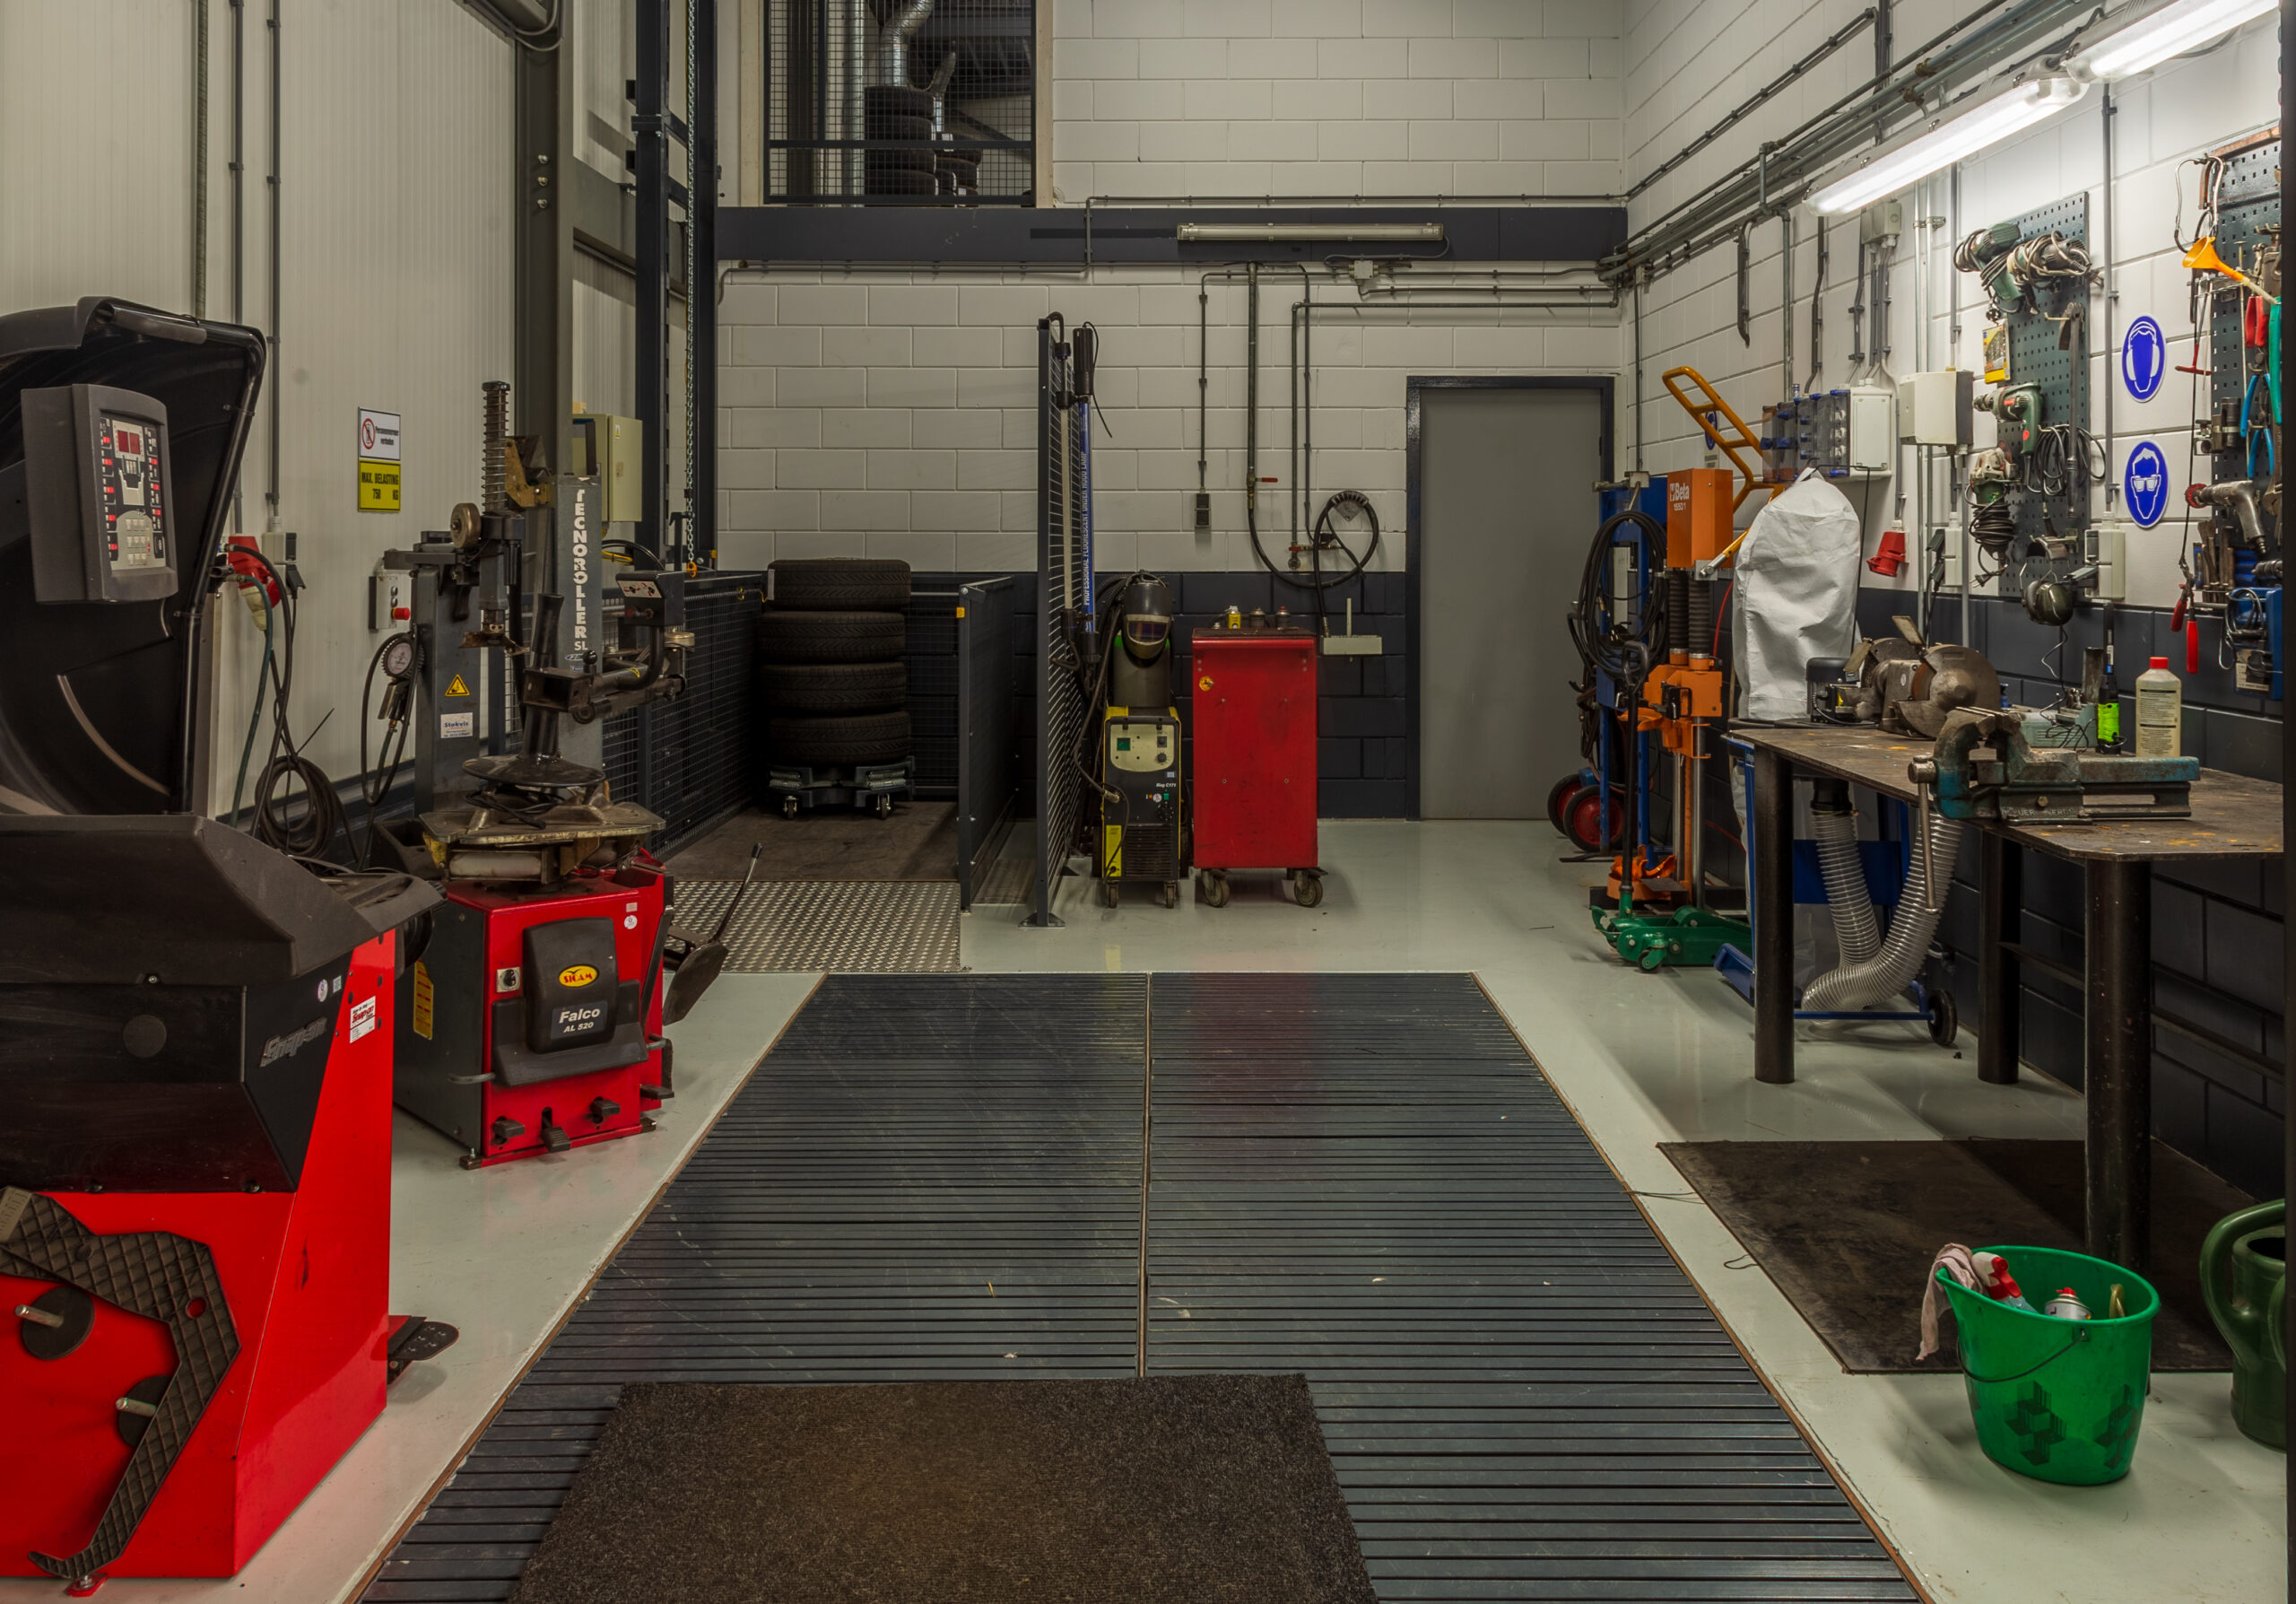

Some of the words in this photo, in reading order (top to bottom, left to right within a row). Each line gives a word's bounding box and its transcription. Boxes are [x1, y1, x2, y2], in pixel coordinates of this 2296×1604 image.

[361, 472, 373, 484] MAX.
[374, 473, 399, 485] BELASTING
[392, 490, 399, 501] KG
[1674, 483, 1690, 501] Beta
[1083, 559, 1091, 606] PROFESSIONAL
[574, 641, 588, 651] SL
[563, 972, 593, 984] SICAM
[559, 1008, 601, 1024] Falco
[563, 1024, 576, 1033] AL
[577, 1022, 594, 1032] 520
